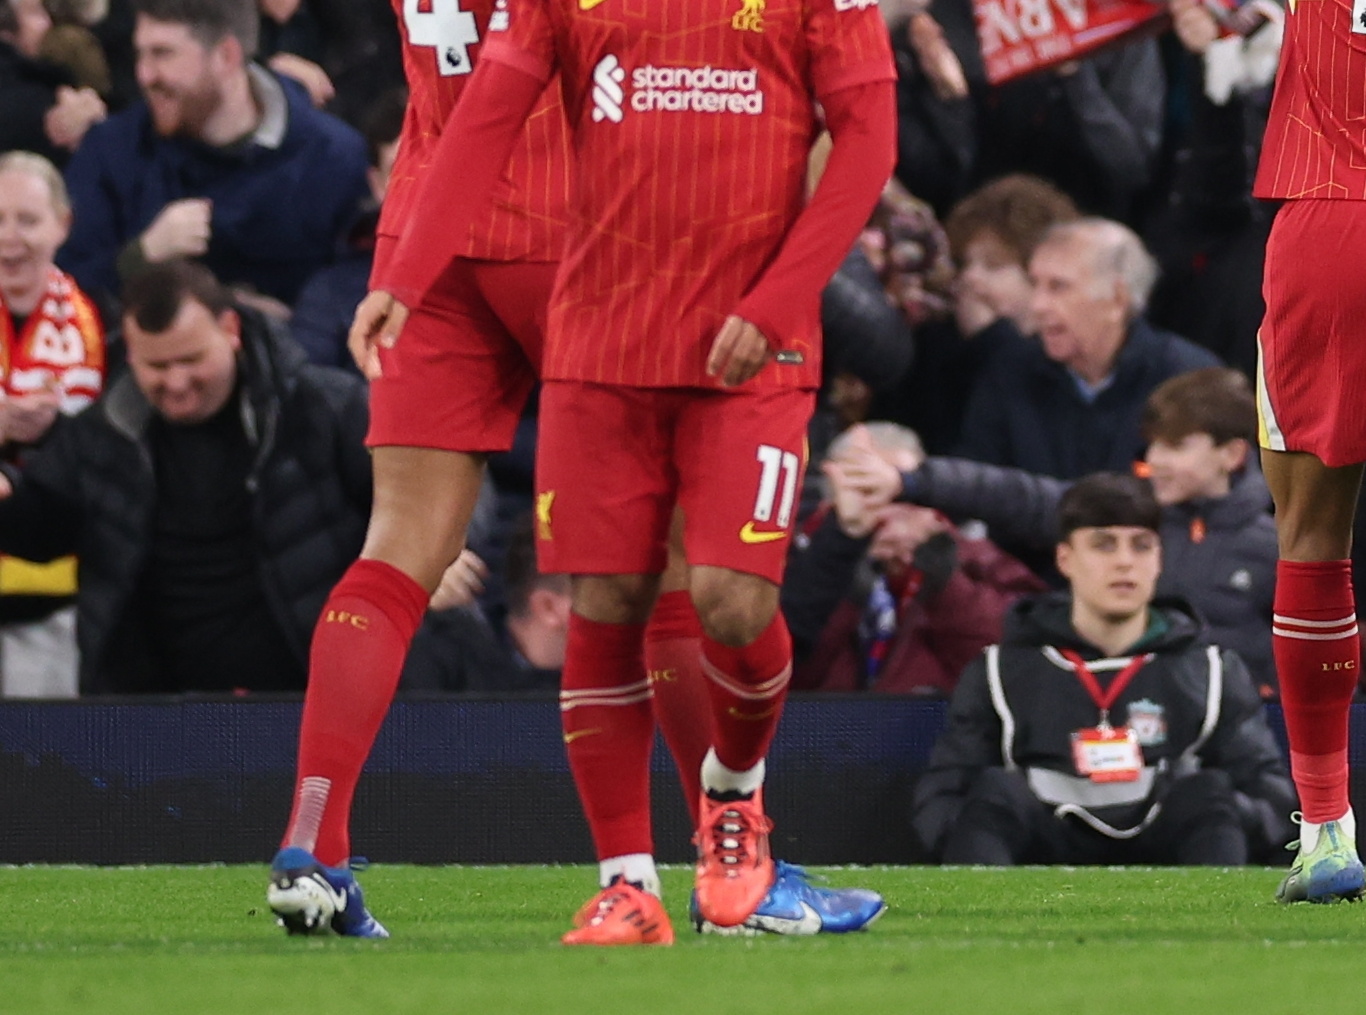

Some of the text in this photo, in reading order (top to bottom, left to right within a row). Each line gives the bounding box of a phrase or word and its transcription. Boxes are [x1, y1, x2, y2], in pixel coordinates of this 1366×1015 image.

[631, 64, 758, 91] standard
[630, 89, 764, 115] chartered
[754, 444, 798, 528] 11
[1321, 659, 1355, 672] LFC
